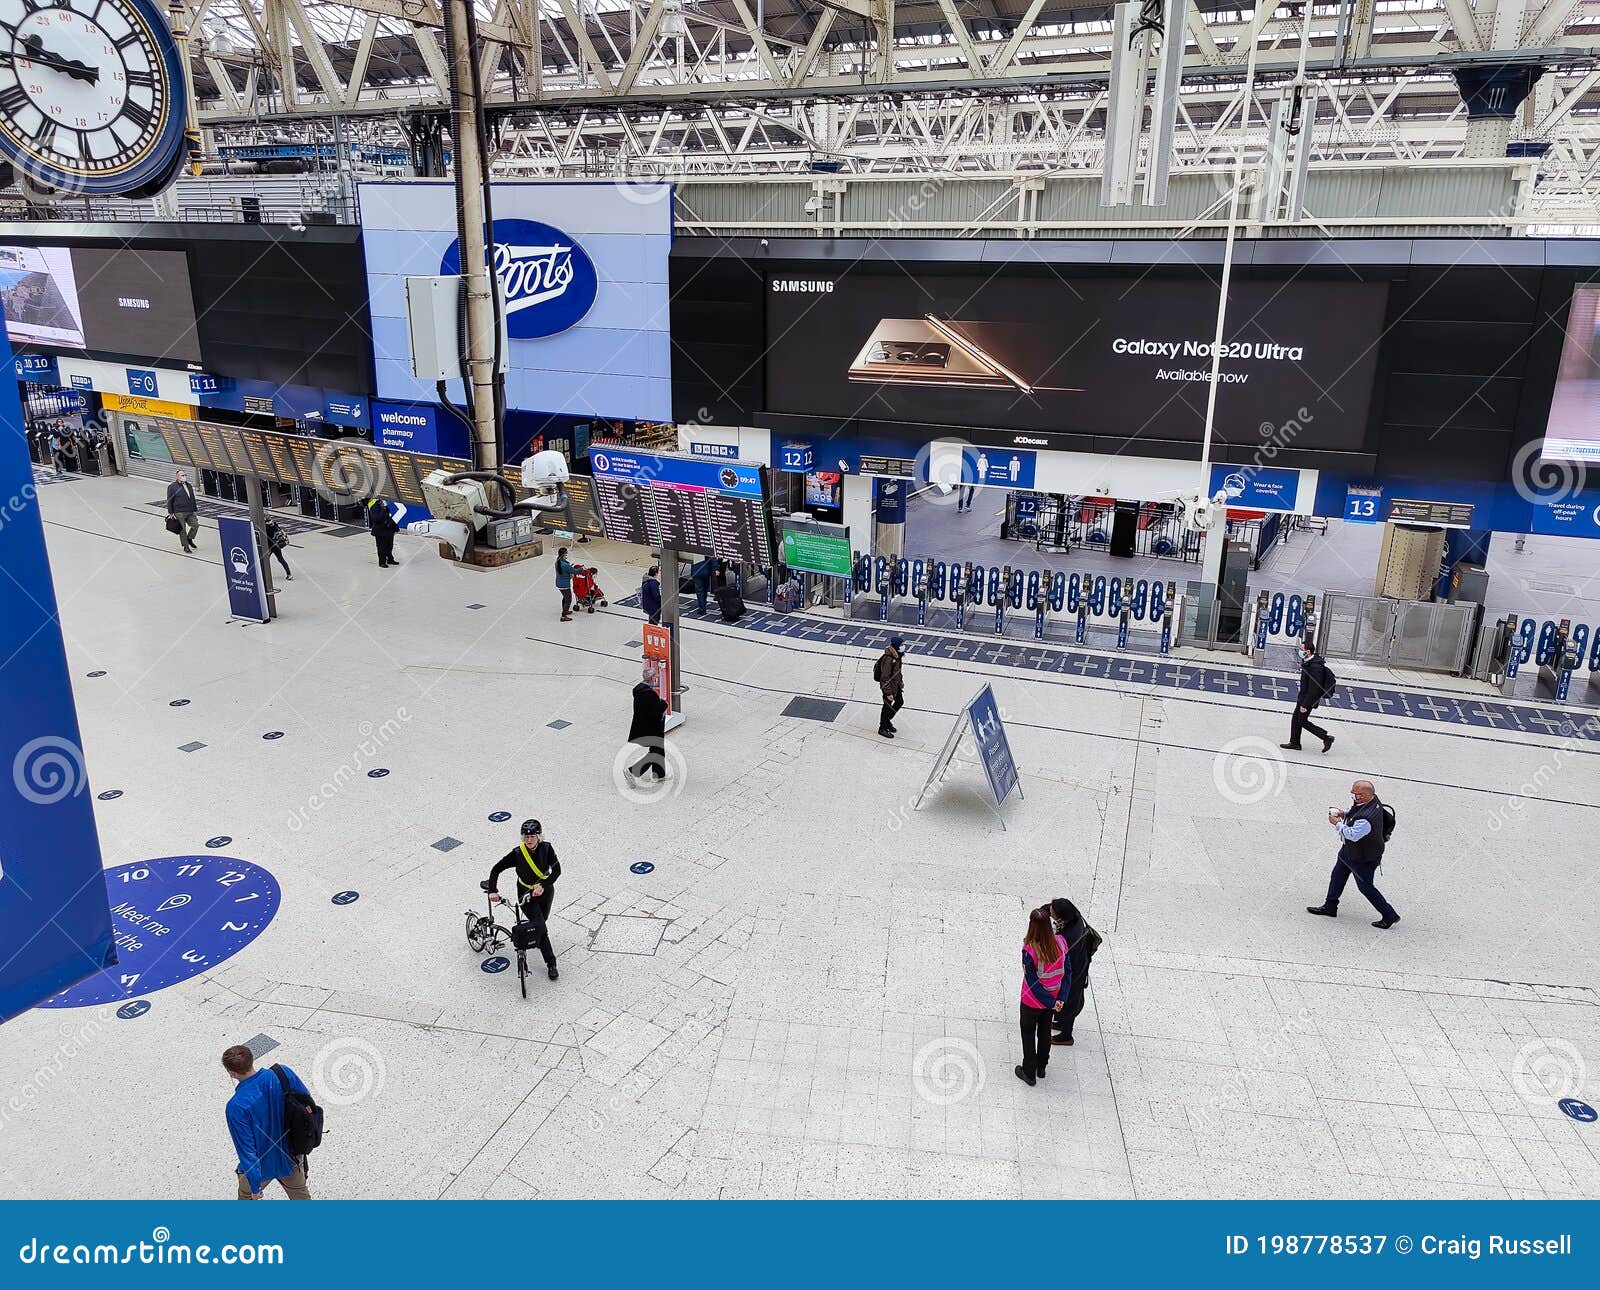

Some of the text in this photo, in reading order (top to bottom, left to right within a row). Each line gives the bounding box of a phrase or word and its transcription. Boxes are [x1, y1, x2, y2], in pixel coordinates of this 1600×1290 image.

[84, 24, 96, 33] 13
[104, 46, 114, 56] 14
[113, 73, 124, 82] 15
[30, 84, 42, 94] 20
[110, 96, 121, 105] 16
[50, 106, 62, 116] 19
[97, 112, 109, 122] 17
[75, 118, 86, 127] 18
[772, 280, 834, 292] SAMSUNG
[118, 298, 150, 310] SAMSUNG
[1112, 338, 1304, 361] Galaxy Note20 Ultra
[34, 358, 48, 368] 10
[1155, 368, 1248, 384] Available now
[190, 378, 200, 390] 11
[203, 378, 216, 390] 11
[380, 412, 426, 426] welcome
[382, 428, 414, 438] pharmacy
[384, 438, 404, 448] beauty
[1014, 436, 1048, 446] JCDecaux
[784, 452, 800, 466] 12
[804, 451, 812, 466] 12
[1020, 502, 1035, 513] 12
[1350, 500, 1374, 516] 13
[118, 868, 149, 883] 10
[176, 864, 203, 876] 11
[216, 871, 246, 886] 12
[234, 892, 259, 902] 1
[110, 902, 151, 924] Meet
[142, 922, 170, 936] me
[221, 921, 248, 931] 2
[115, 934, 143, 951] the
[182, 949, 206, 963] 3
[120, 973, 140, 987] 4
